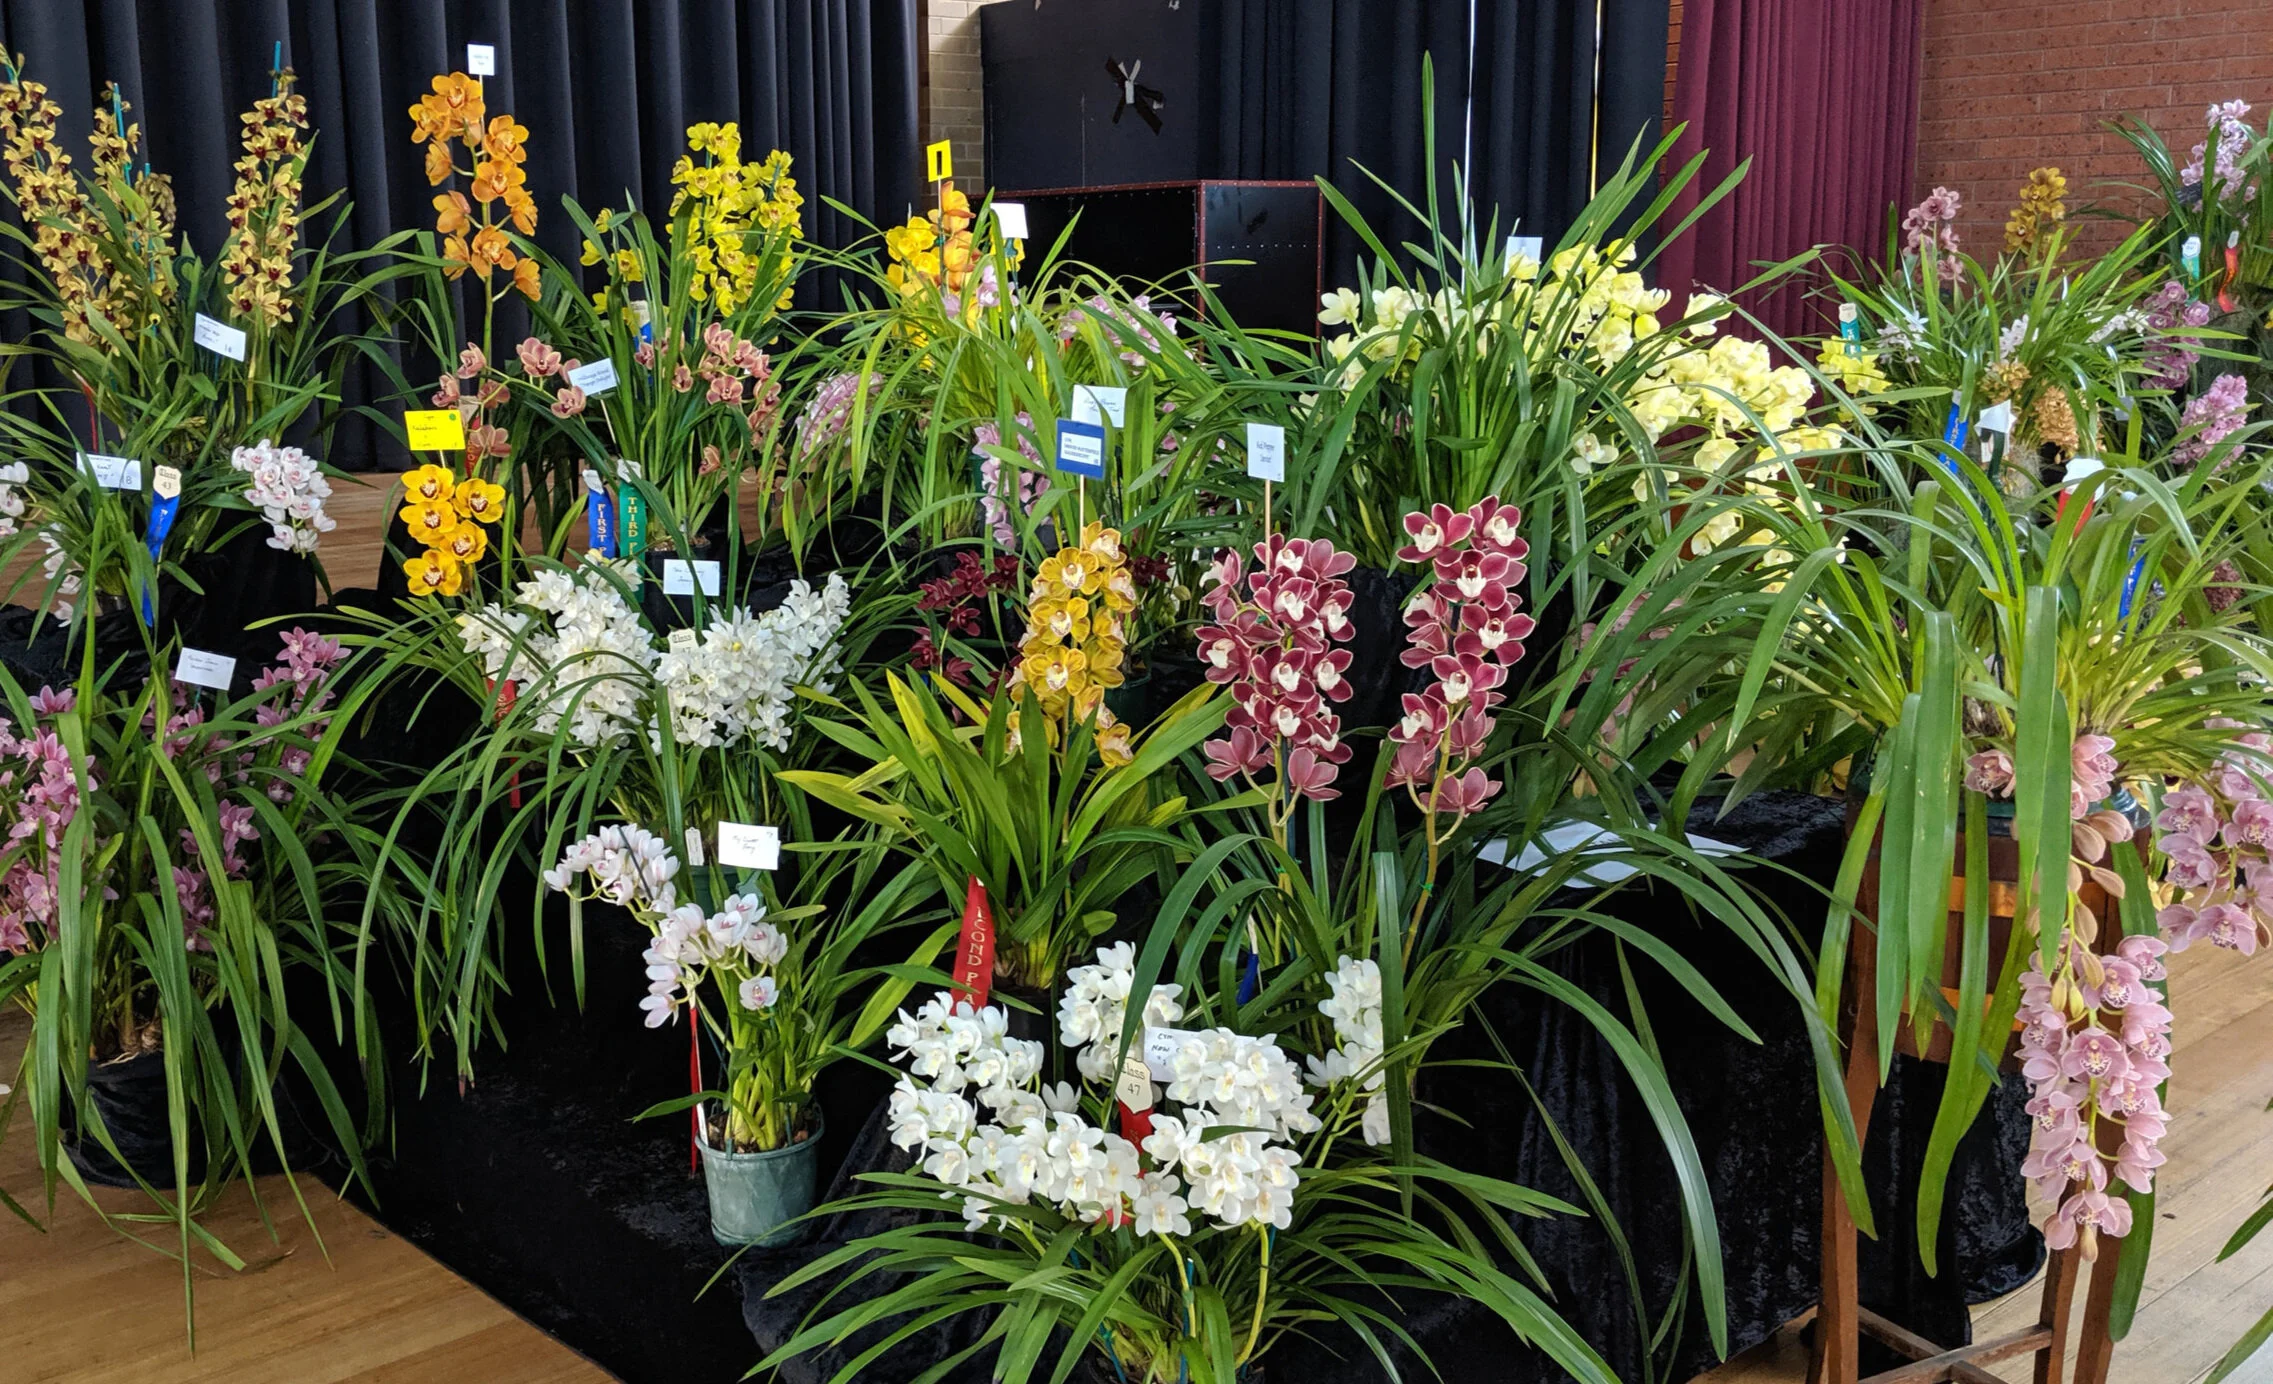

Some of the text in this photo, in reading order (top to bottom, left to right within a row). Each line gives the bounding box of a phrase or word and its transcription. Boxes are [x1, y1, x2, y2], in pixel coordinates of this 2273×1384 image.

[597, 504, 607, 542] FIRST
[628, 497, 638, 537] THIRD
[1127, 1083, 1141, 1097] 47
